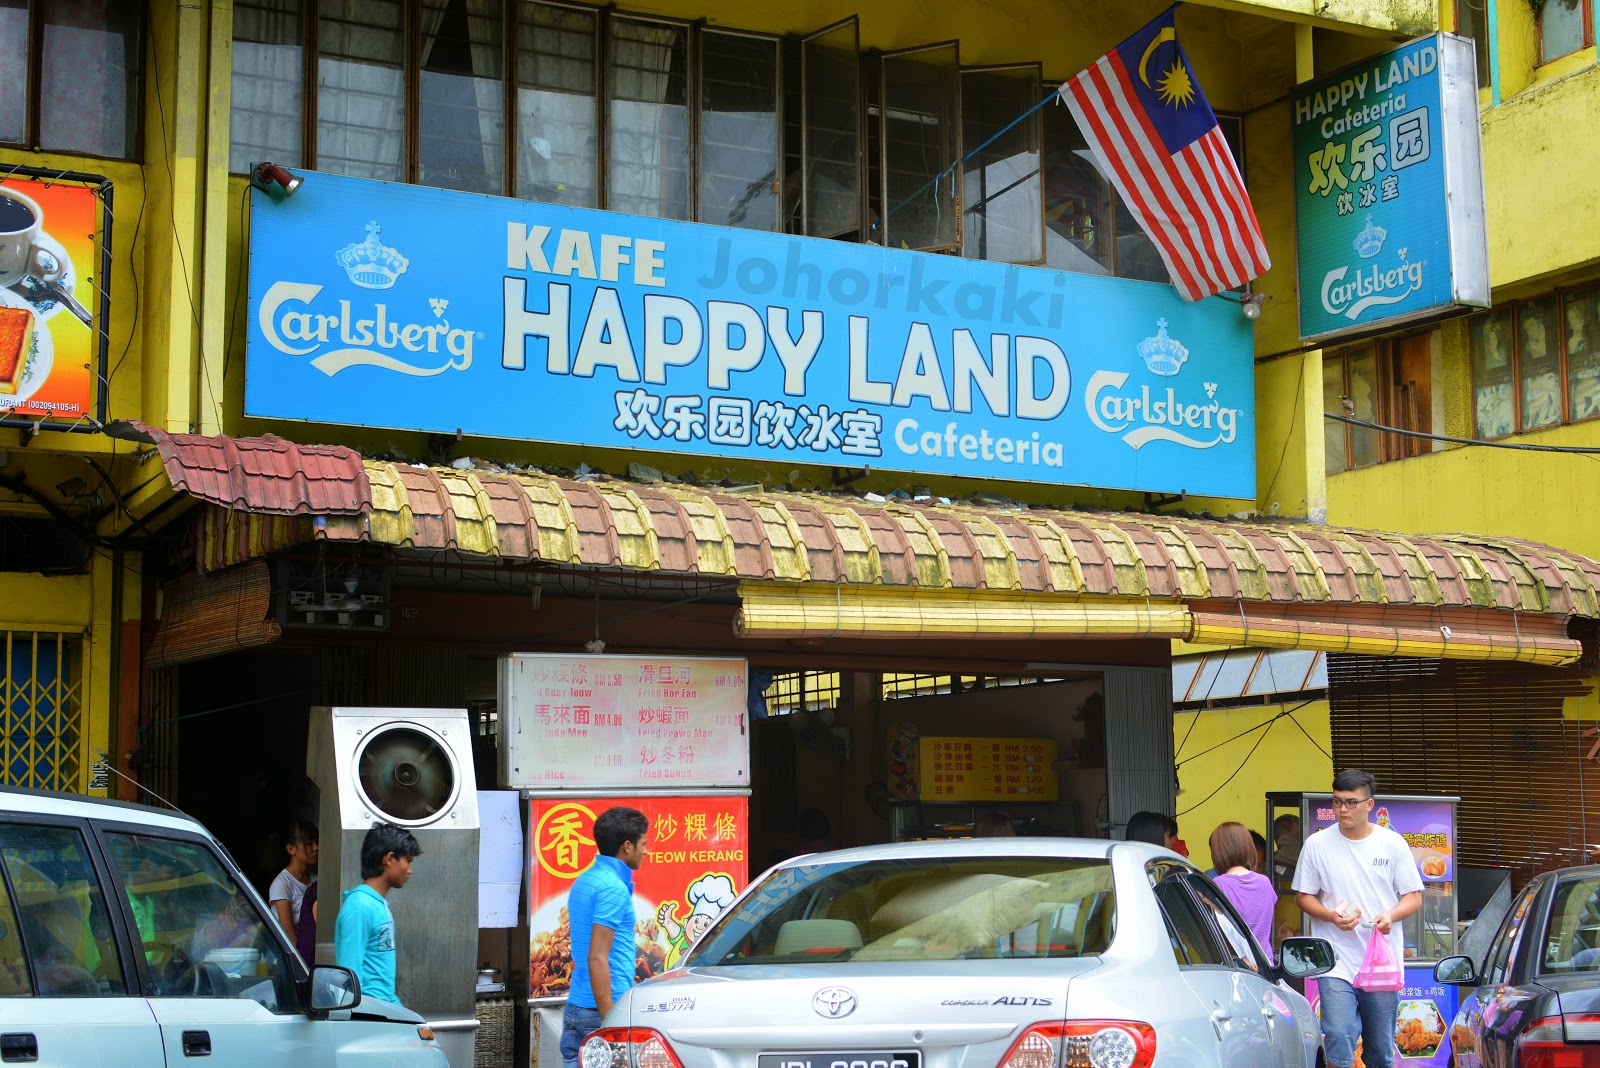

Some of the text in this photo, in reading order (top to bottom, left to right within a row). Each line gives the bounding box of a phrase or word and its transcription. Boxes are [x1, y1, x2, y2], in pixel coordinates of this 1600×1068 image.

[1296, 46, 1438, 125] HAPPY LAND
[1320, 91, 1407, 139] Cafeteria
[1308, 106, 1431, 197] 欢乐园
[1336, 174, 1400, 217] 饮冰室
[507, 221, 667, 288] KAFE
[1320, 258, 1424, 316] Carlsberg
[259, 280, 477, 373] Carlsberg
[501, 276, 1072, 421] HAPPY LAND
[28, 400, 80, 412] (002094105-H)
[1085, 369, 1240, 445] Carlsberg
[614, 389, 883, 458] 欢乐园饮冰室
[895, 417, 1065, 468] Cafeteria
[569, 687, 593, 698] Teow
[663, 688, 680, 699] Hor
[681, 688, 697, 699] Fan
[594, 713, 623, 727] RM 4.00
[567, 727, 588, 738] Mee
[638, 728, 661, 739] Fried
[1005, 744, 1019, 752] RM
[1005, 754, 1020, 762] RM
[544, 769, 565, 780] Rice
[639, 768, 662, 779] Fried
[1006, 764, 1020, 772] RM
[1006, 775, 1020, 783] RM
[541, 811, 598, 870] 香
[648, 849, 744, 864] TEOW KERANG
[991, 995, 1054, 1006] ALTIS
